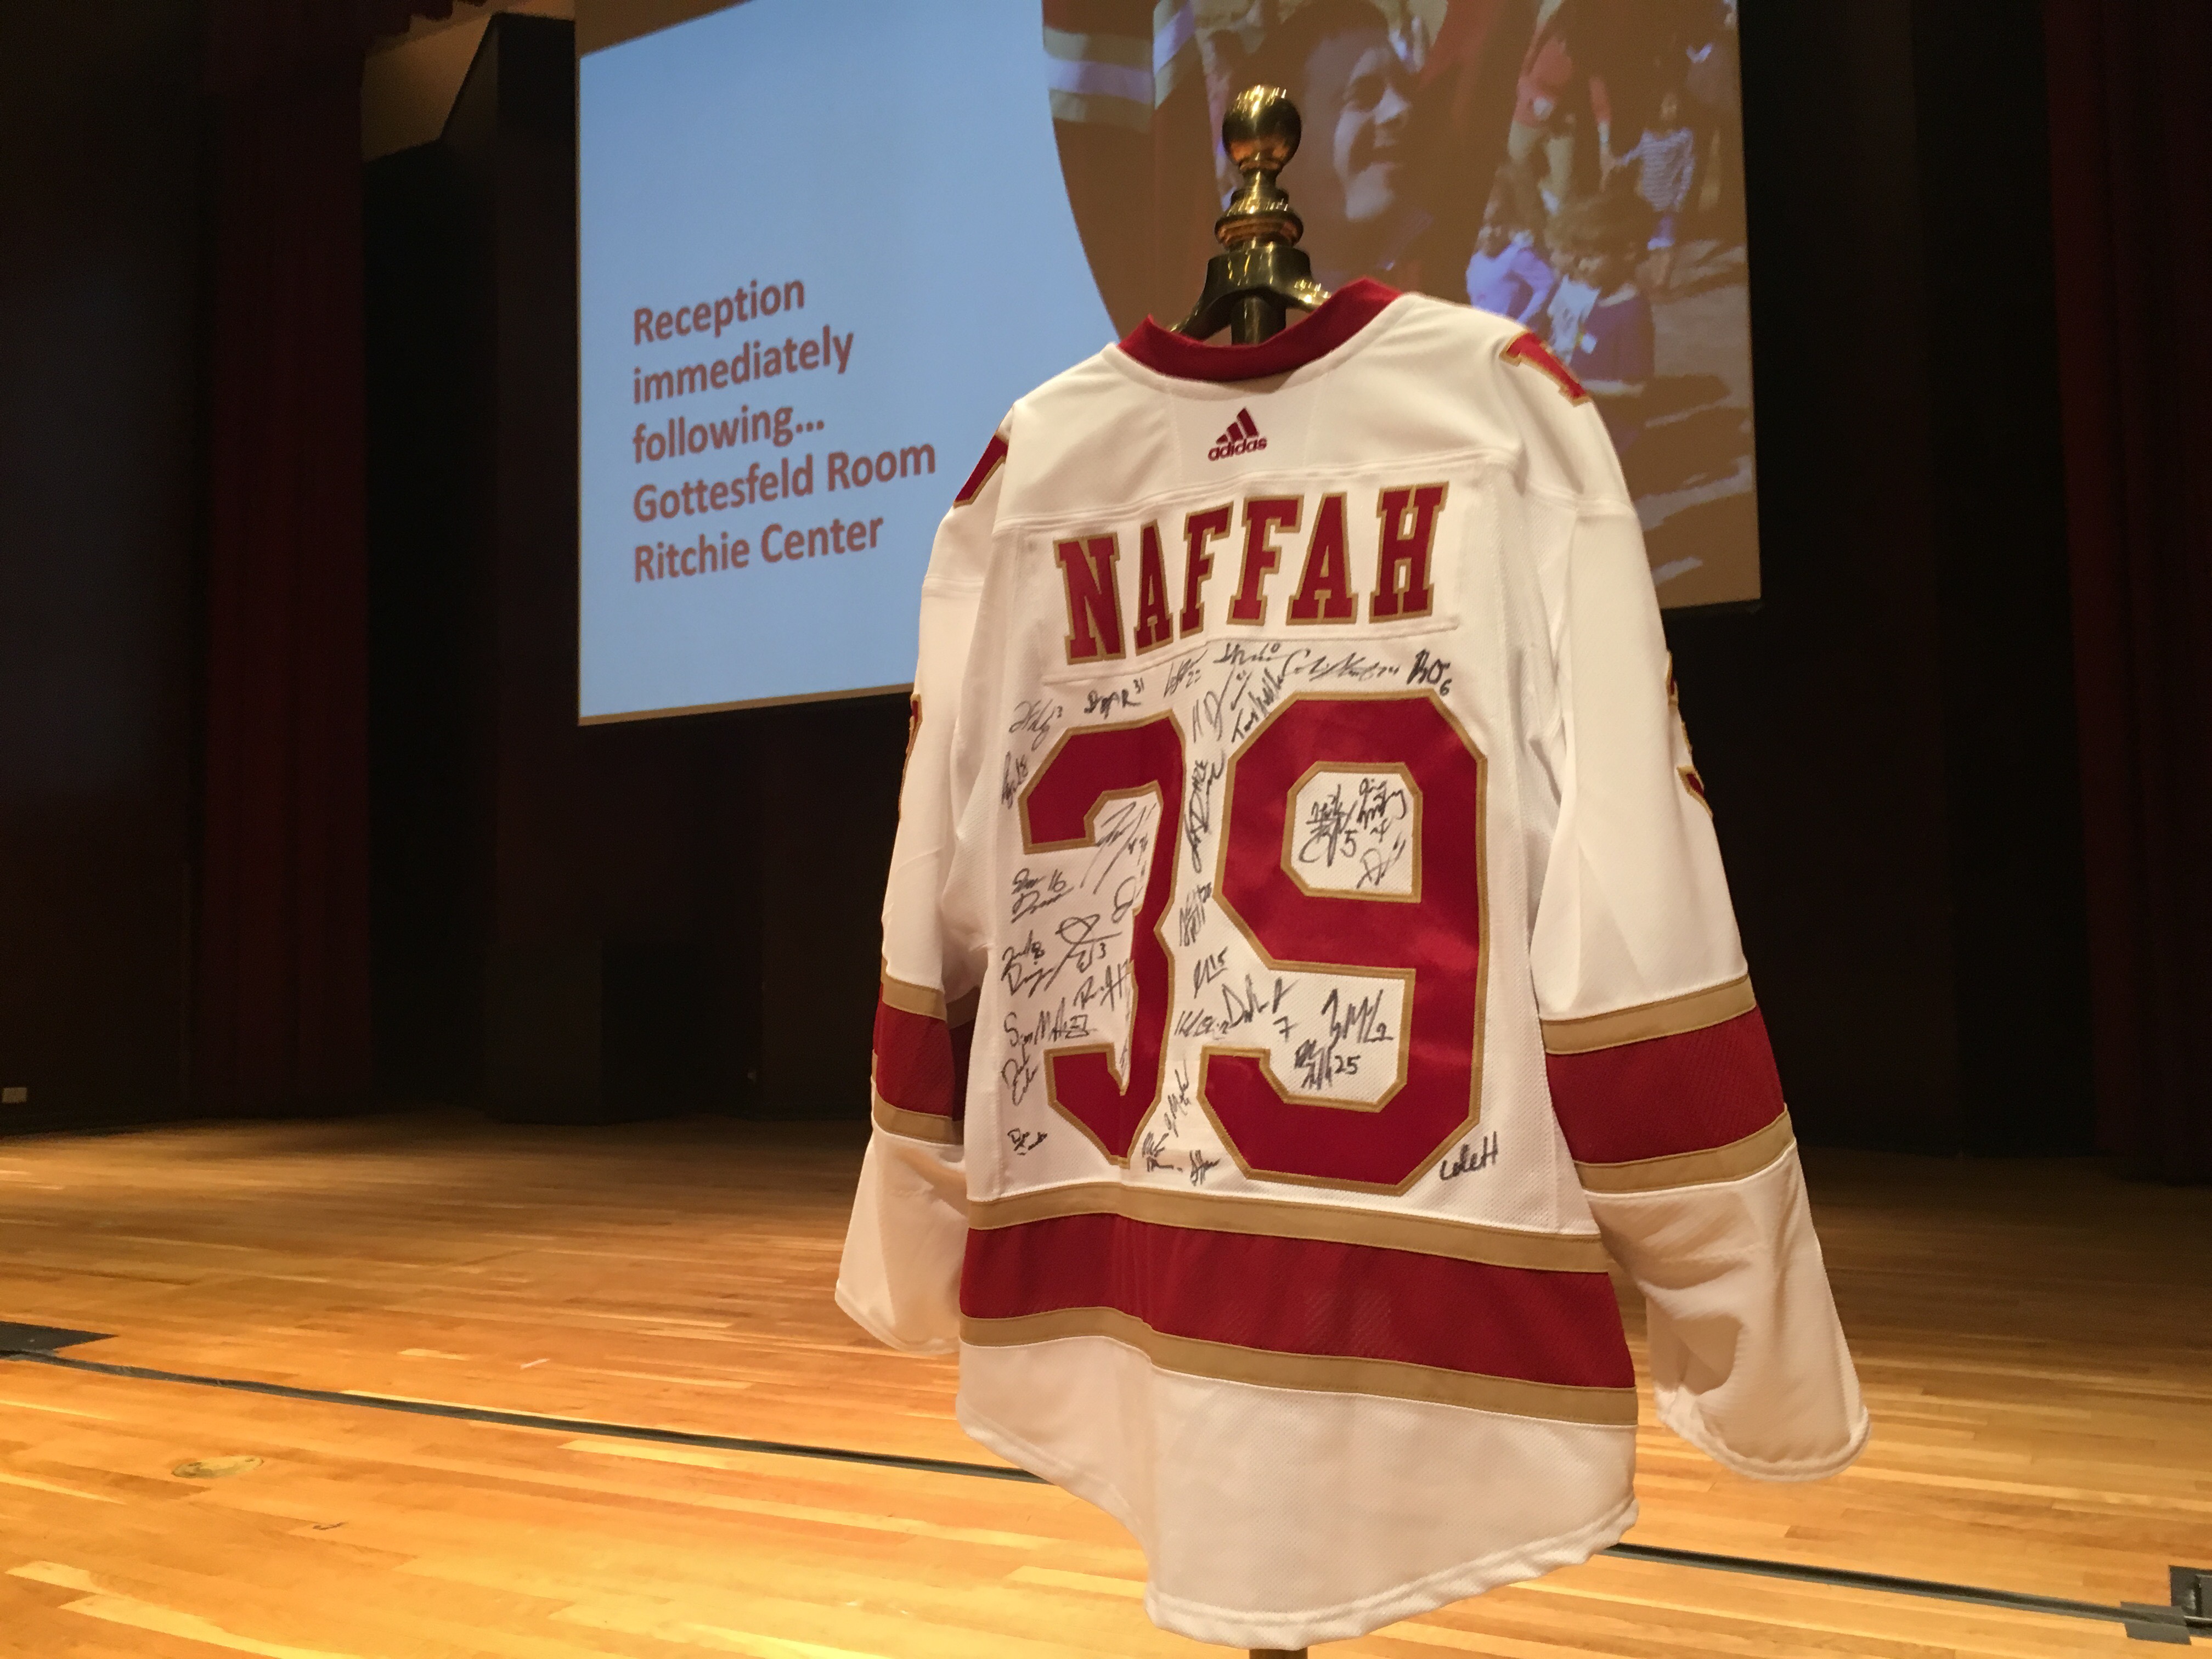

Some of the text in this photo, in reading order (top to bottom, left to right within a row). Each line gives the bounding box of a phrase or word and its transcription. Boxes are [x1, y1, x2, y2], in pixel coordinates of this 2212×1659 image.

[634, 278, 804, 345] Reception
[634, 324, 853, 403] immediately
[633, 404, 824, 463] following...
[1208, 437, 1268, 461] adidas
[634, 443, 935, 522] Gottesfeld Room
[635, 517, 883, 583] Ritchie Center
[1053, 481, 1449, 664] NAFFAH
